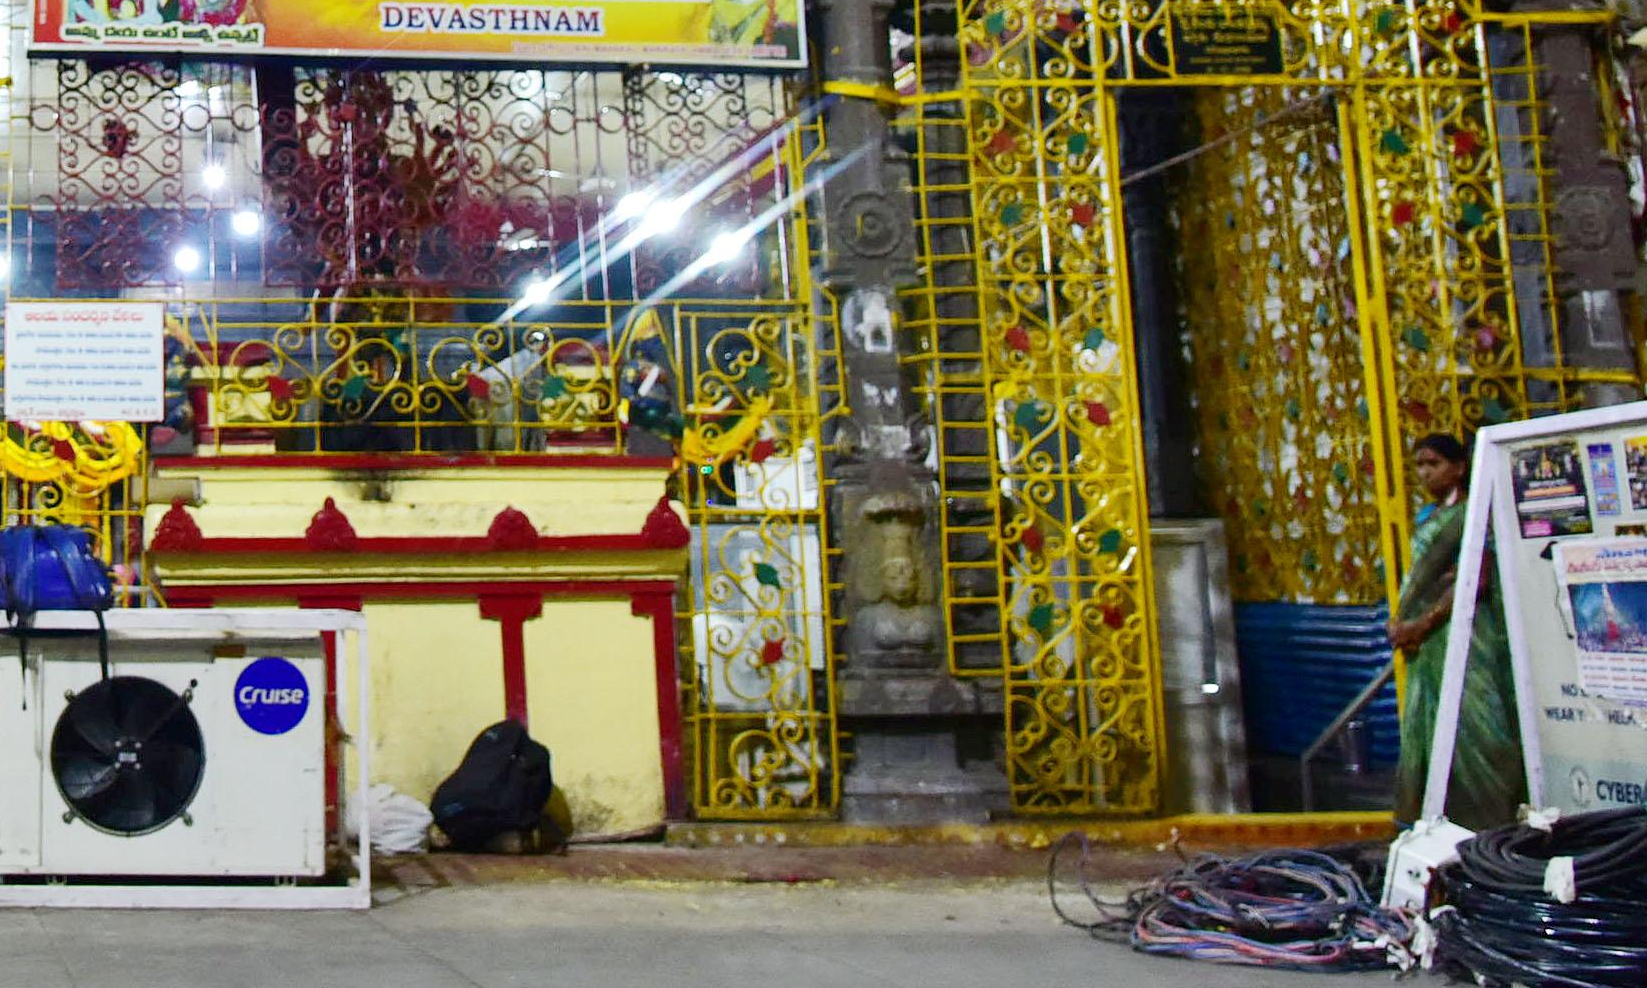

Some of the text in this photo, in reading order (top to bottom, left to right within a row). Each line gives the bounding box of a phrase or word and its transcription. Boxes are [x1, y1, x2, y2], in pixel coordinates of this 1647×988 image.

[382, 5, 601, 32] DEVASTHNAM
[239, 685, 304, 705] Cruise
[1596, 779, 1647, 805] CYBER
